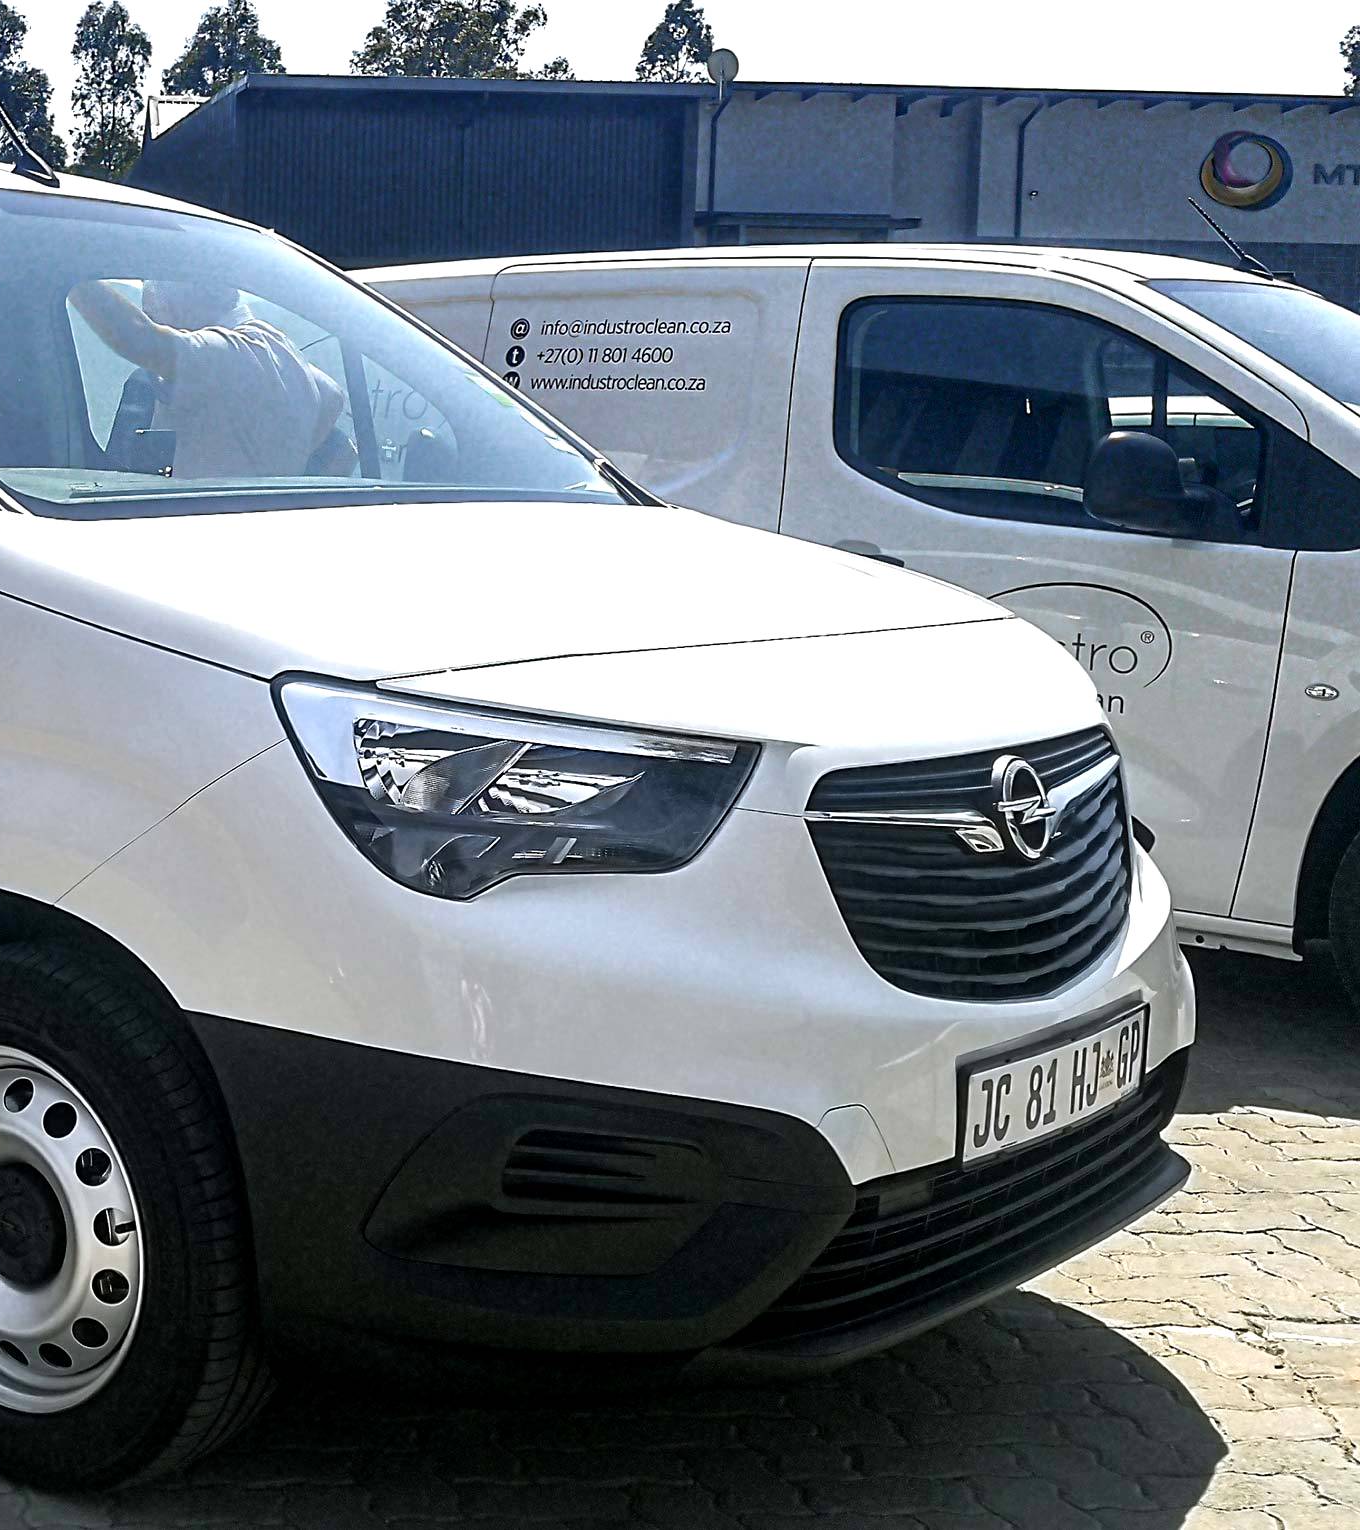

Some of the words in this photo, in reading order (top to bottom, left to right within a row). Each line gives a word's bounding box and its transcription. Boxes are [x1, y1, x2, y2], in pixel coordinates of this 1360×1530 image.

[541, 318, 732, 338] info@industroclean.co.za
[536, 347, 584, 366] +27(0)
[588, 347, 599, 364] 11
[601, 346, 628, 364] 801
[630, 346, 674, 364] 4600
[530, 374, 707, 391] www.industroclean.co.za
[973, 1073, 1013, 1149] JC
[1026, 1057, 1058, 1130] 81
[1069, 1041, 1101, 1115] HJ
[1116, 1019, 1140, 1089] GP
